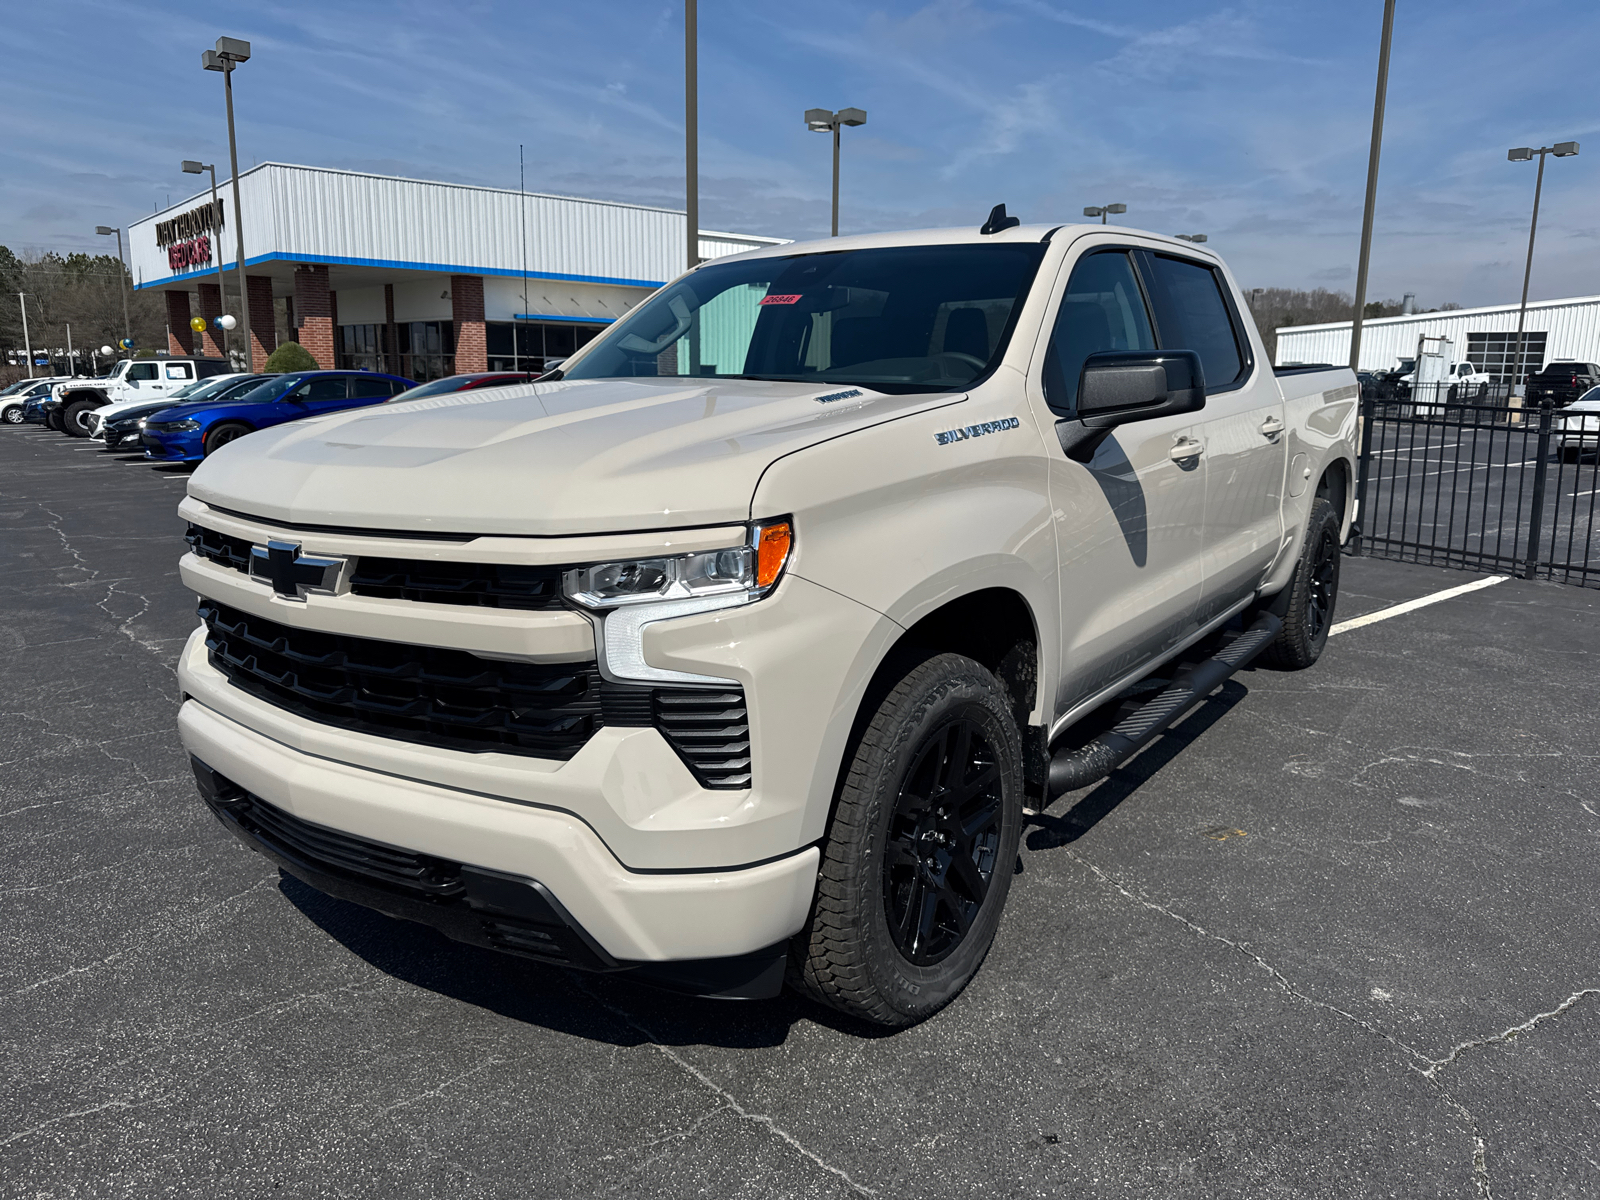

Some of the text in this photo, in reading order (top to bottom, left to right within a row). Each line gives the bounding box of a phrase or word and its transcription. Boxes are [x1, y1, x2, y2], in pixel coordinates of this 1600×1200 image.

[168, 235, 209, 270] USED CARS
[933, 416, 1020, 446] SILVERADO
